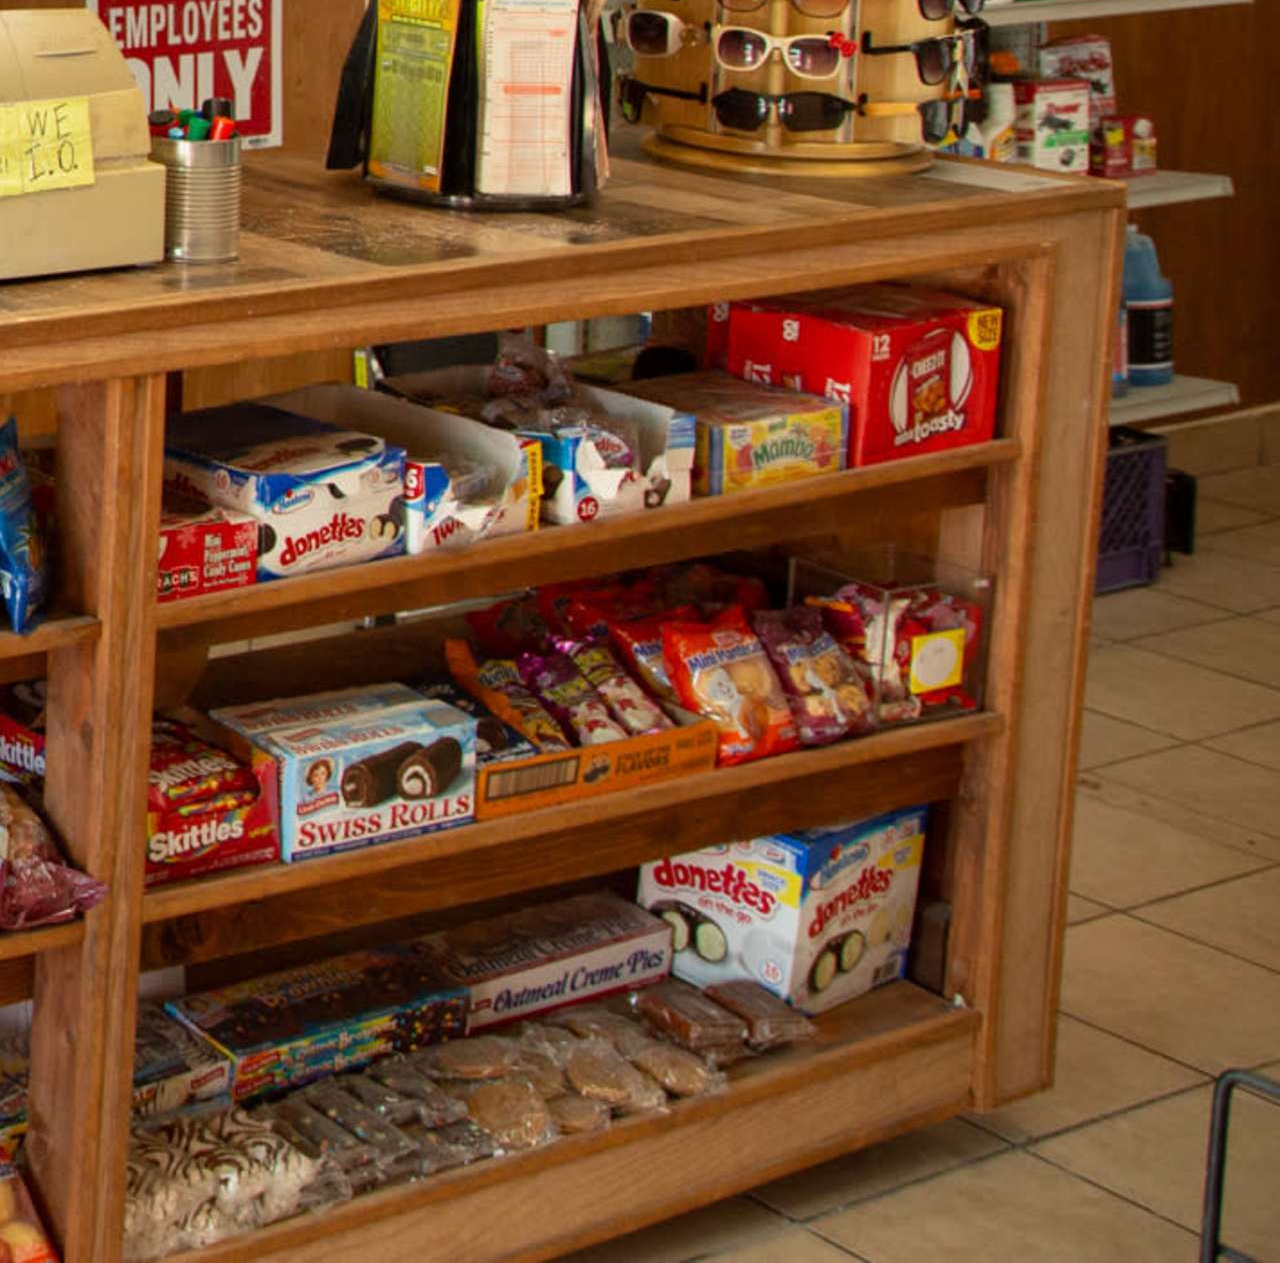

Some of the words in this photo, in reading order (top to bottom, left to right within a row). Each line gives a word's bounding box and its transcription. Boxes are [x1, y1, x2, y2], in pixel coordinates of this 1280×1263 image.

[872, 334, 891, 353] 12
[578, 499, 598, 517] 16
[279, 512, 366, 566] donettes
[148, 817, 245, 863] Skittles
[297, 811, 383, 848] SWISS
[390, 794, 471, 828] ROLLS
[654, 857, 777, 916] donettes
[808, 866, 894, 938] donettes
[492, 983, 568, 1016] Oatmeal
[569, 963, 625, 995] Creme
[626, 944, 667, 974] Pies
